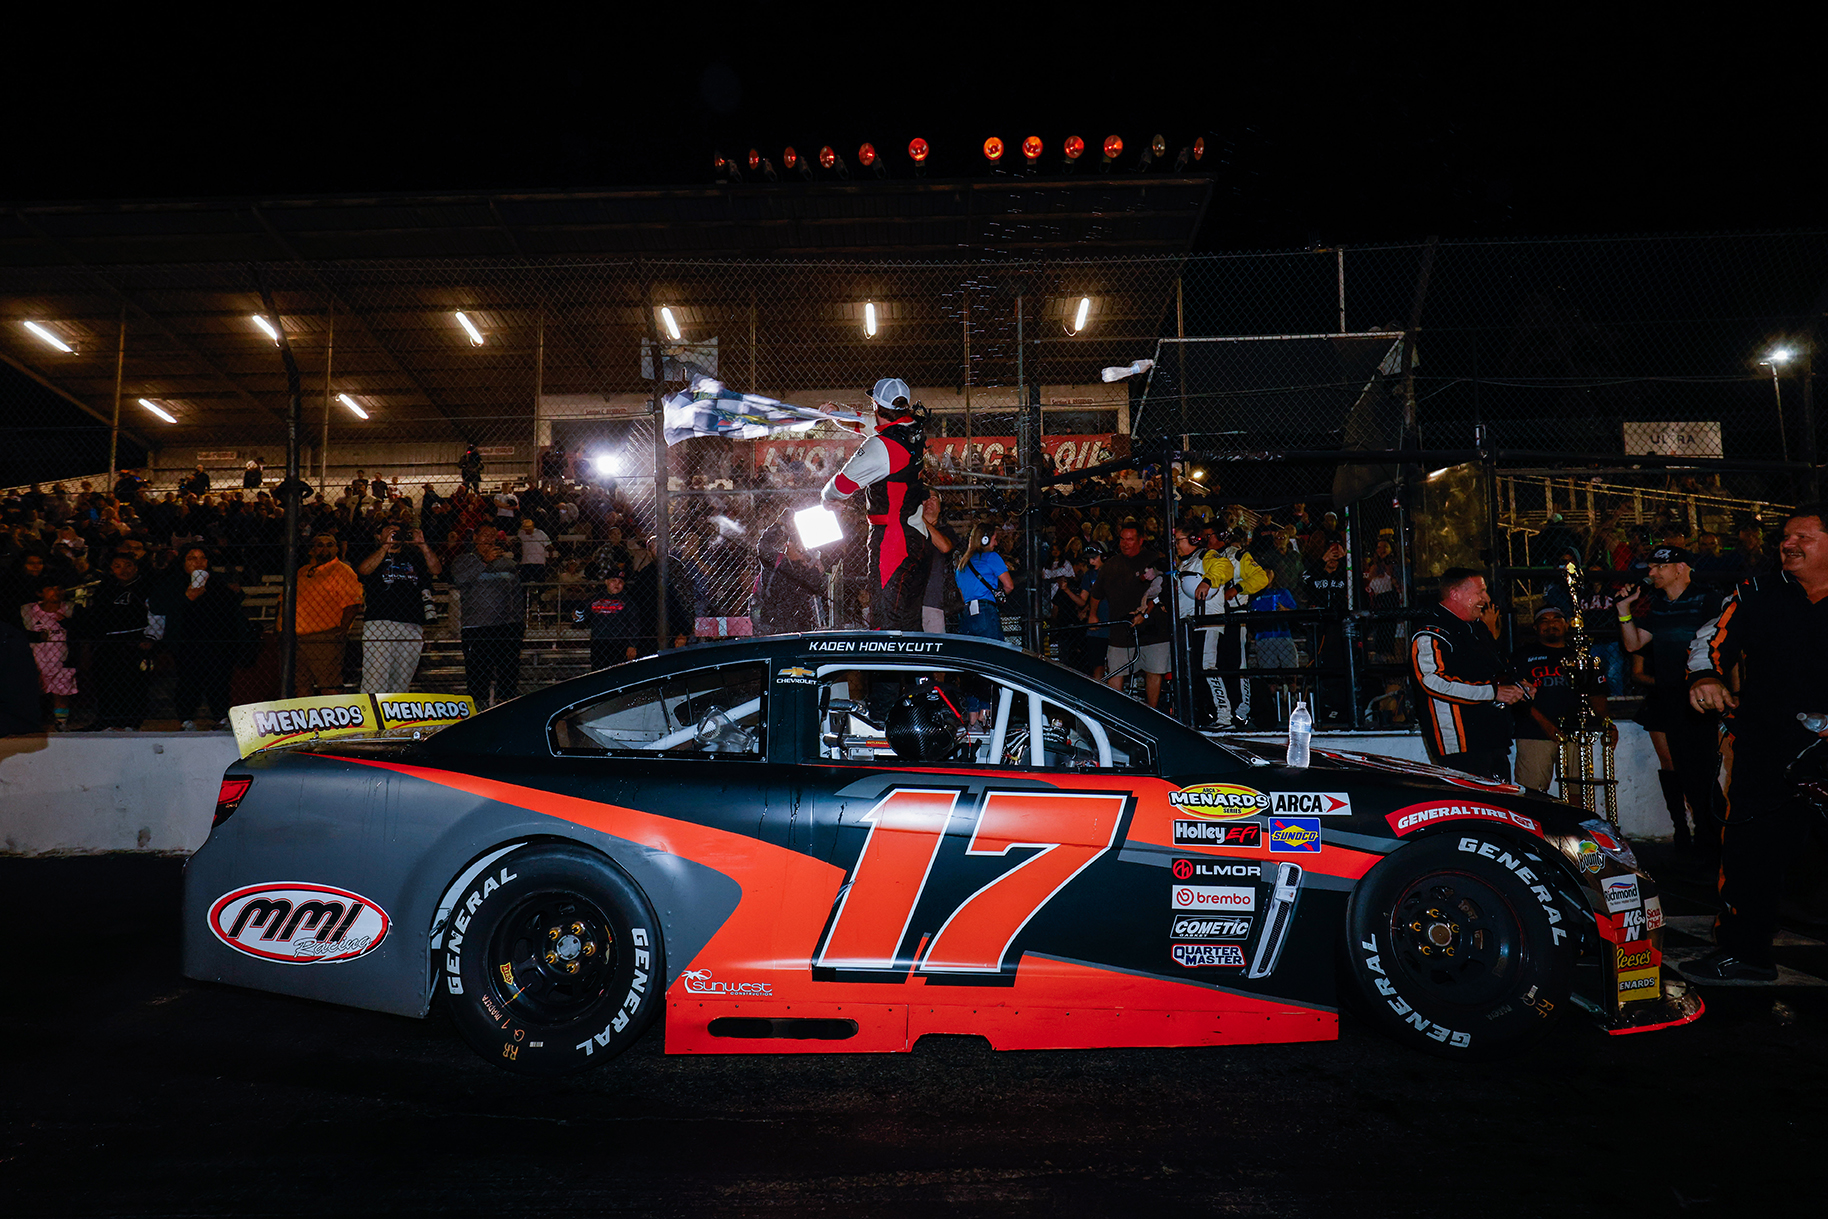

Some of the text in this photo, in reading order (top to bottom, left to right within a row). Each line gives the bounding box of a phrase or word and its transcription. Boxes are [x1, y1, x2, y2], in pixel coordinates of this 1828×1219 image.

[1650, 434, 1696, 444] ULRA
[809, 641, 943, 652] KADEN HONEYCUTT
[381, 701, 469, 721] MENARDS
[254, 706, 364, 737] MENARDS
[1169, 792, 1269, 809] MENARDS
[1275, 794, 1323, 813] ARCA
[1398, 806, 1508, 829] GENERAL TIRE
[1176, 822, 1226, 844] Holley
[1274, 830, 1317, 842] SUNOCO
[1196, 865, 1261, 876] ILMOR
[1578, 850, 1605, 873] Bounty
[815, 787, 1128, 973] 17
[1197, 892, 1251, 905] brembo
[1458, 837, 1568, 947] GENERAL
[1604, 883, 1638, 901] Richmond
[226, 897, 366, 943] MMI
[1175, 921, 1249, 935] COMETIC
[446, 867, 518, 995] GENERAL
[293, 935, 373, 958] Racing
[1174, 946, 1240, 959] QUARTER
[1186, 955, 1243, 965] MASTER
[575, 928, 650, 1056] GENERAL
[692, 981, 772, 993] sunwest
[1362, 933, 1472, 1048] GENERAL
[1619, 977, 1656, 991] ENARDS
